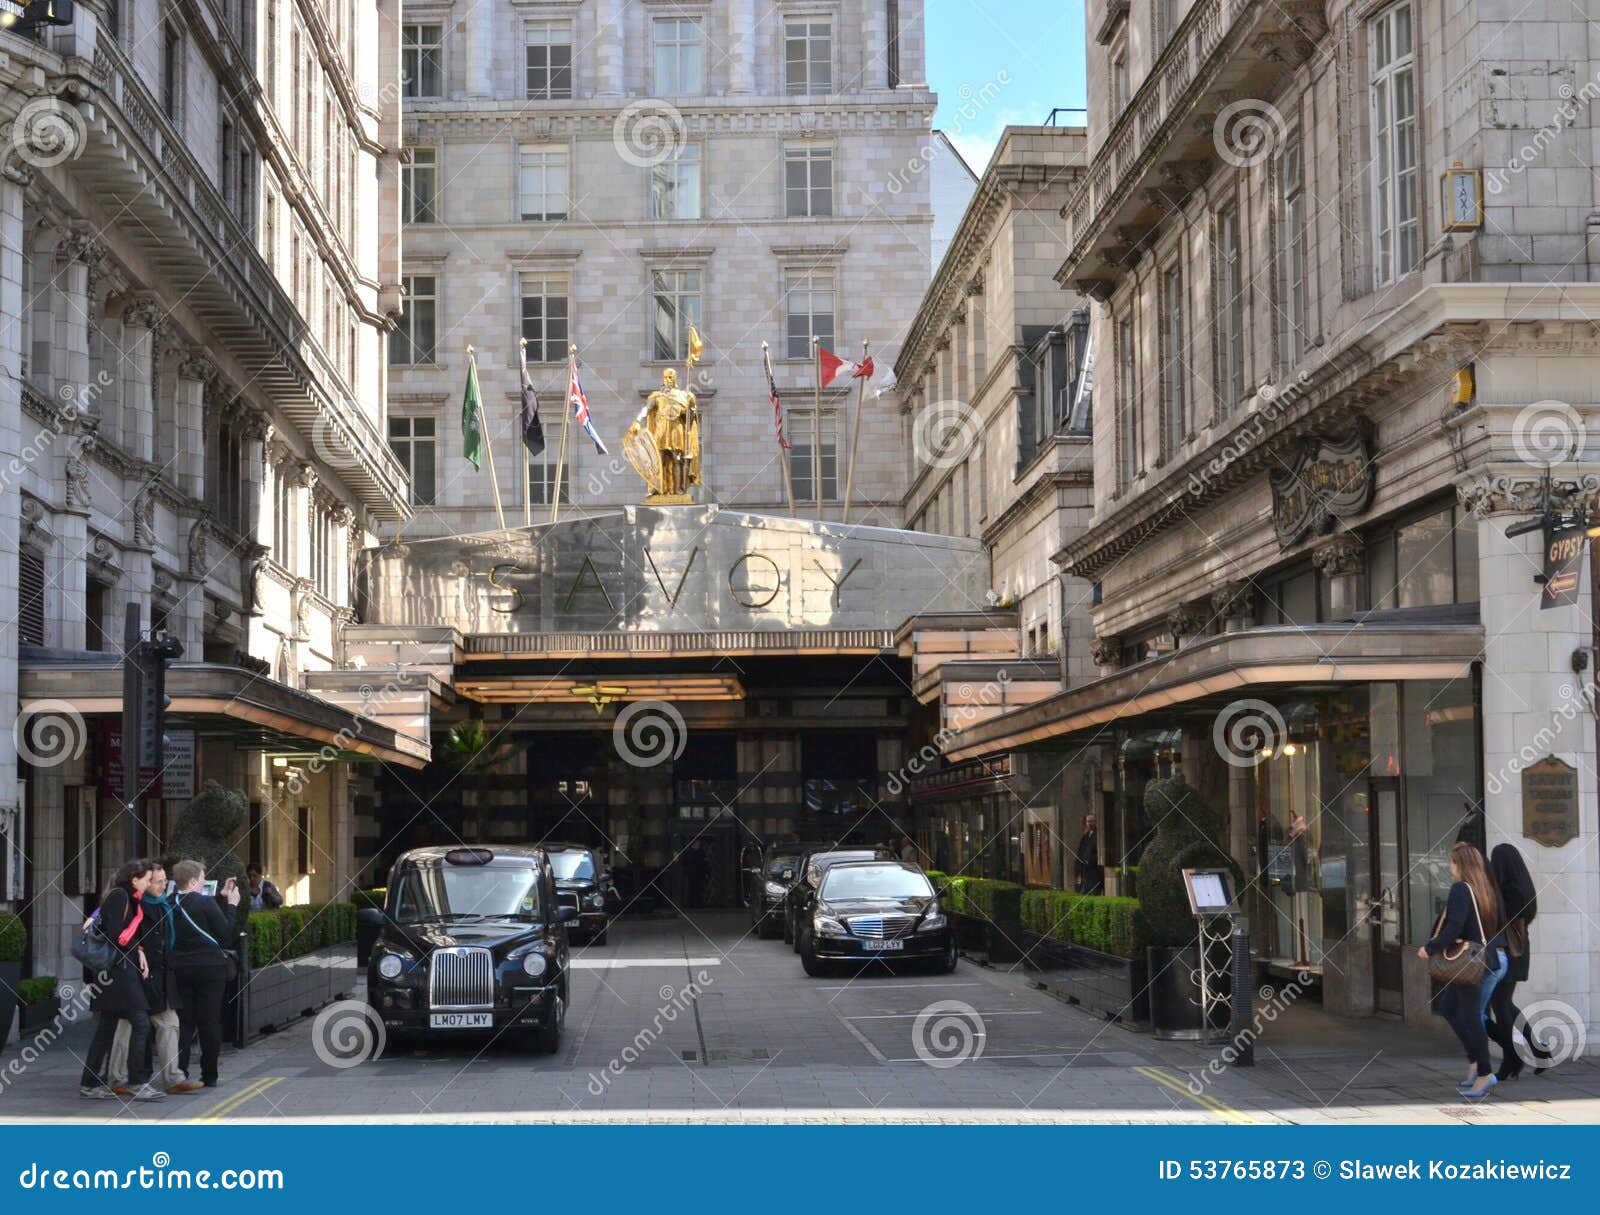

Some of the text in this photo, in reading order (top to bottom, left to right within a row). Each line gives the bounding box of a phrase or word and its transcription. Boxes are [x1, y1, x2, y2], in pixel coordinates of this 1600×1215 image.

[1459, 175, 1468, 220] TAXI
[1550, 536, 1583, 562] GYPSY
[488, 546, 862, 613] SAVOY
[434, 1014, 488, 1026] LM07 LMY
